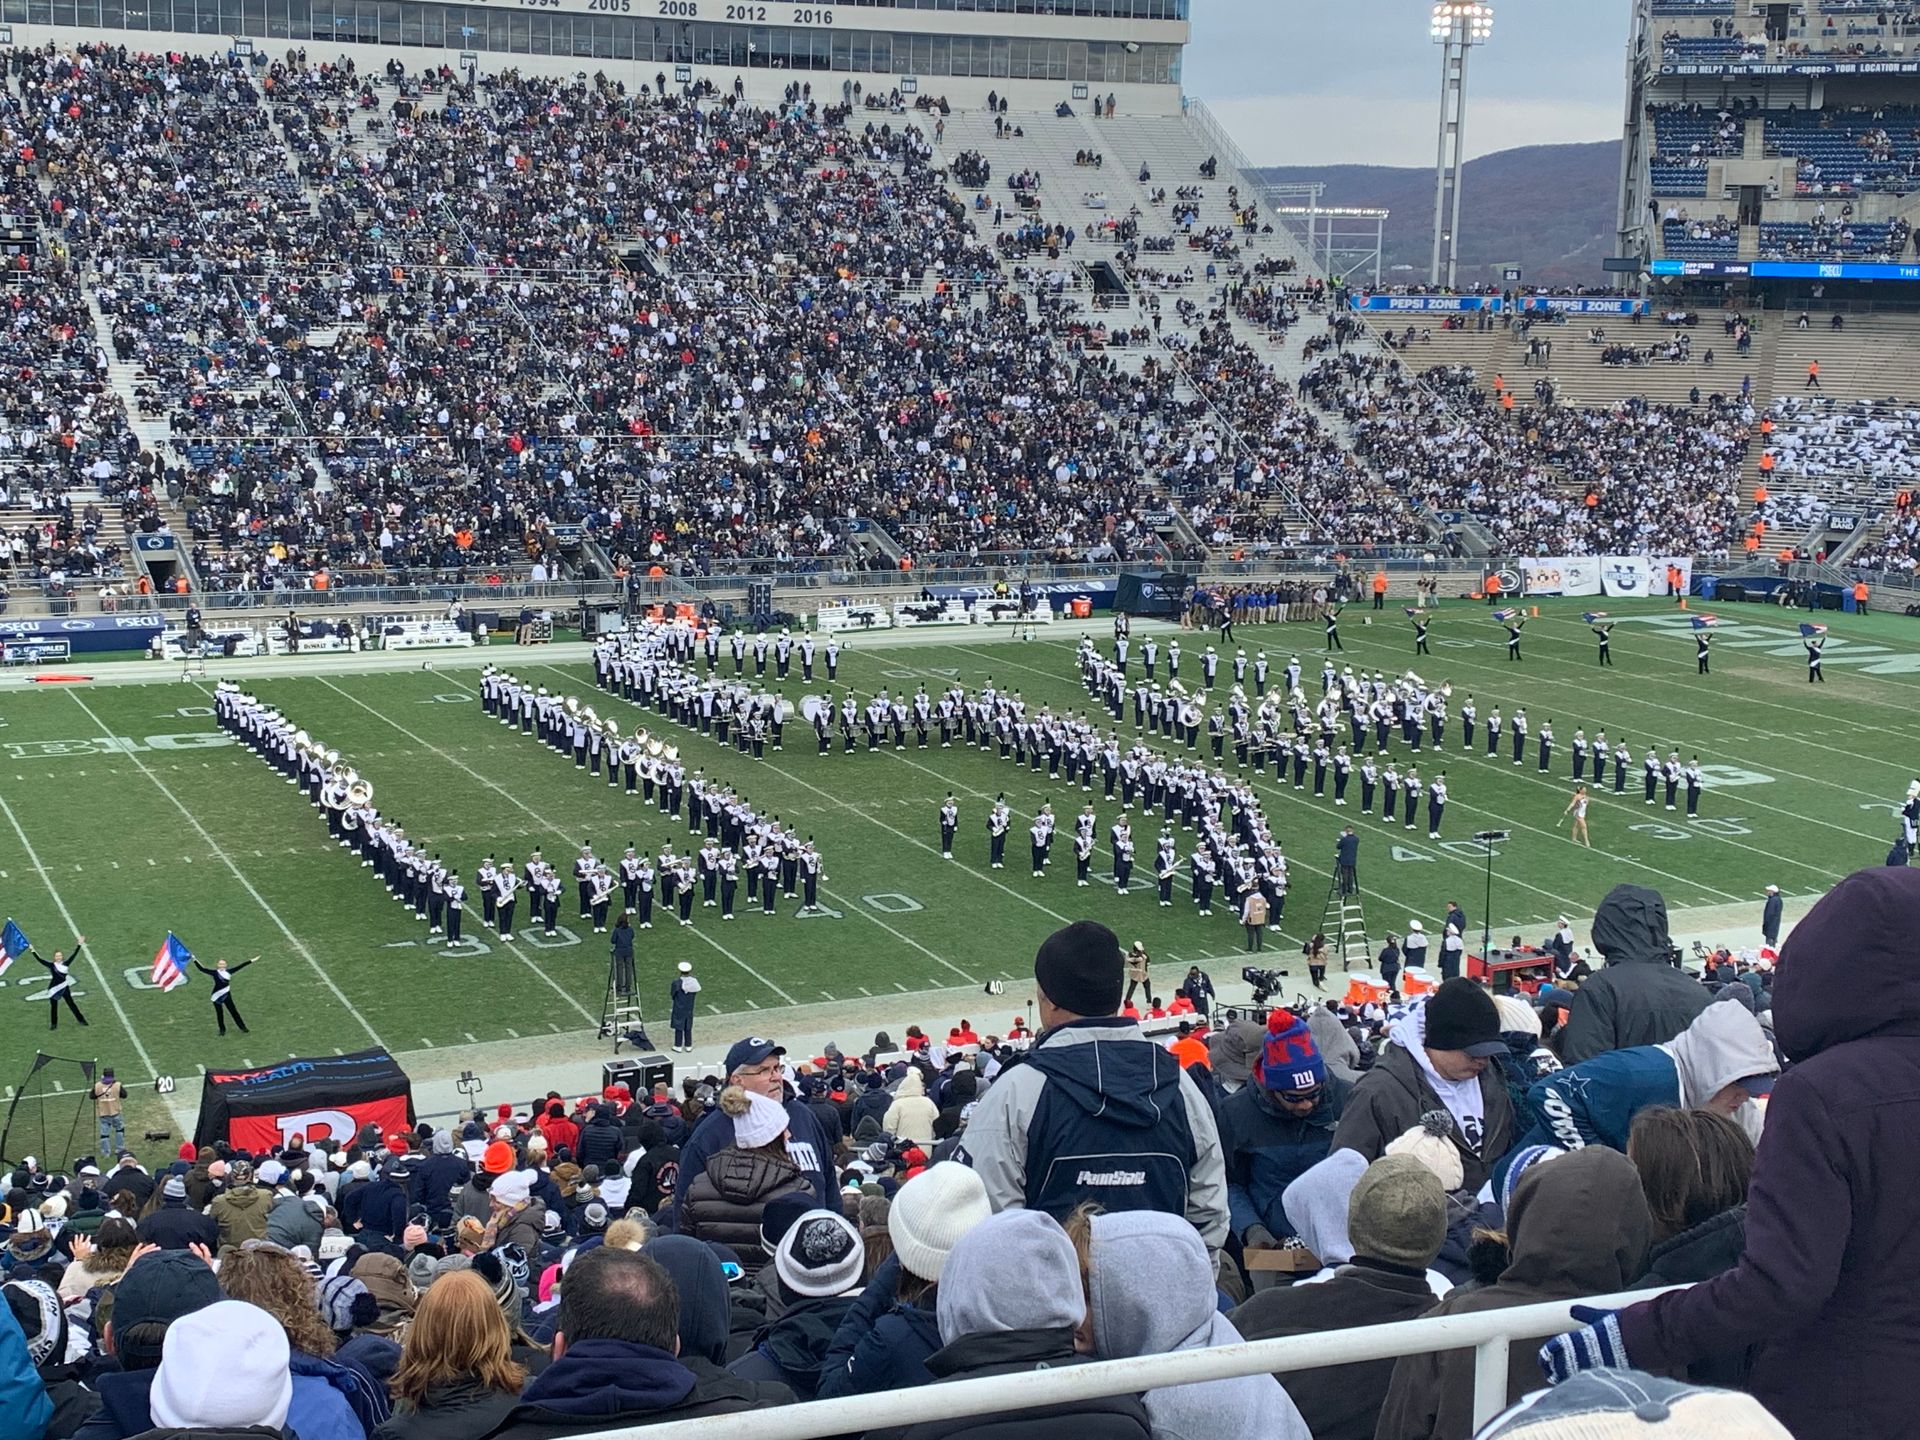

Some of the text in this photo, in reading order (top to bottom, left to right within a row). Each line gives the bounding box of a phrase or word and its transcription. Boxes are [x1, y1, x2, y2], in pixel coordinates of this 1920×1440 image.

[588, 0, 631, 12] 2005
[659, 0, 697, 16] 2008
[726, 5, 766, 21] 2012
[794, 9, 833, 24] 2016
[1677, 65, 1697, 74] NEED
[1699, 65, 1723, 74] HELP?
[1728, 65, 1747, 73] Text
[1835, 64, 1856, 72] YOUR
[1860, 63, 1900, 72] LOCATION
[1902, 63, 1918, 71] and
[1900, 268, 1919, 276] THE
[1390, 299, 1461, 310] PEPSI ZONE
[1547, 301, 1622, 312] PEPSI ZONE
[115, 616, 160, 627] PSECU
[24, 644, 65, 653] UIVALED
[427, 925, 583, 958] 30
[990, 980, 1004, 995] 40
[1266, 1029, 1313, 1066] NY
[157, 1077, 174, 1093] 20
